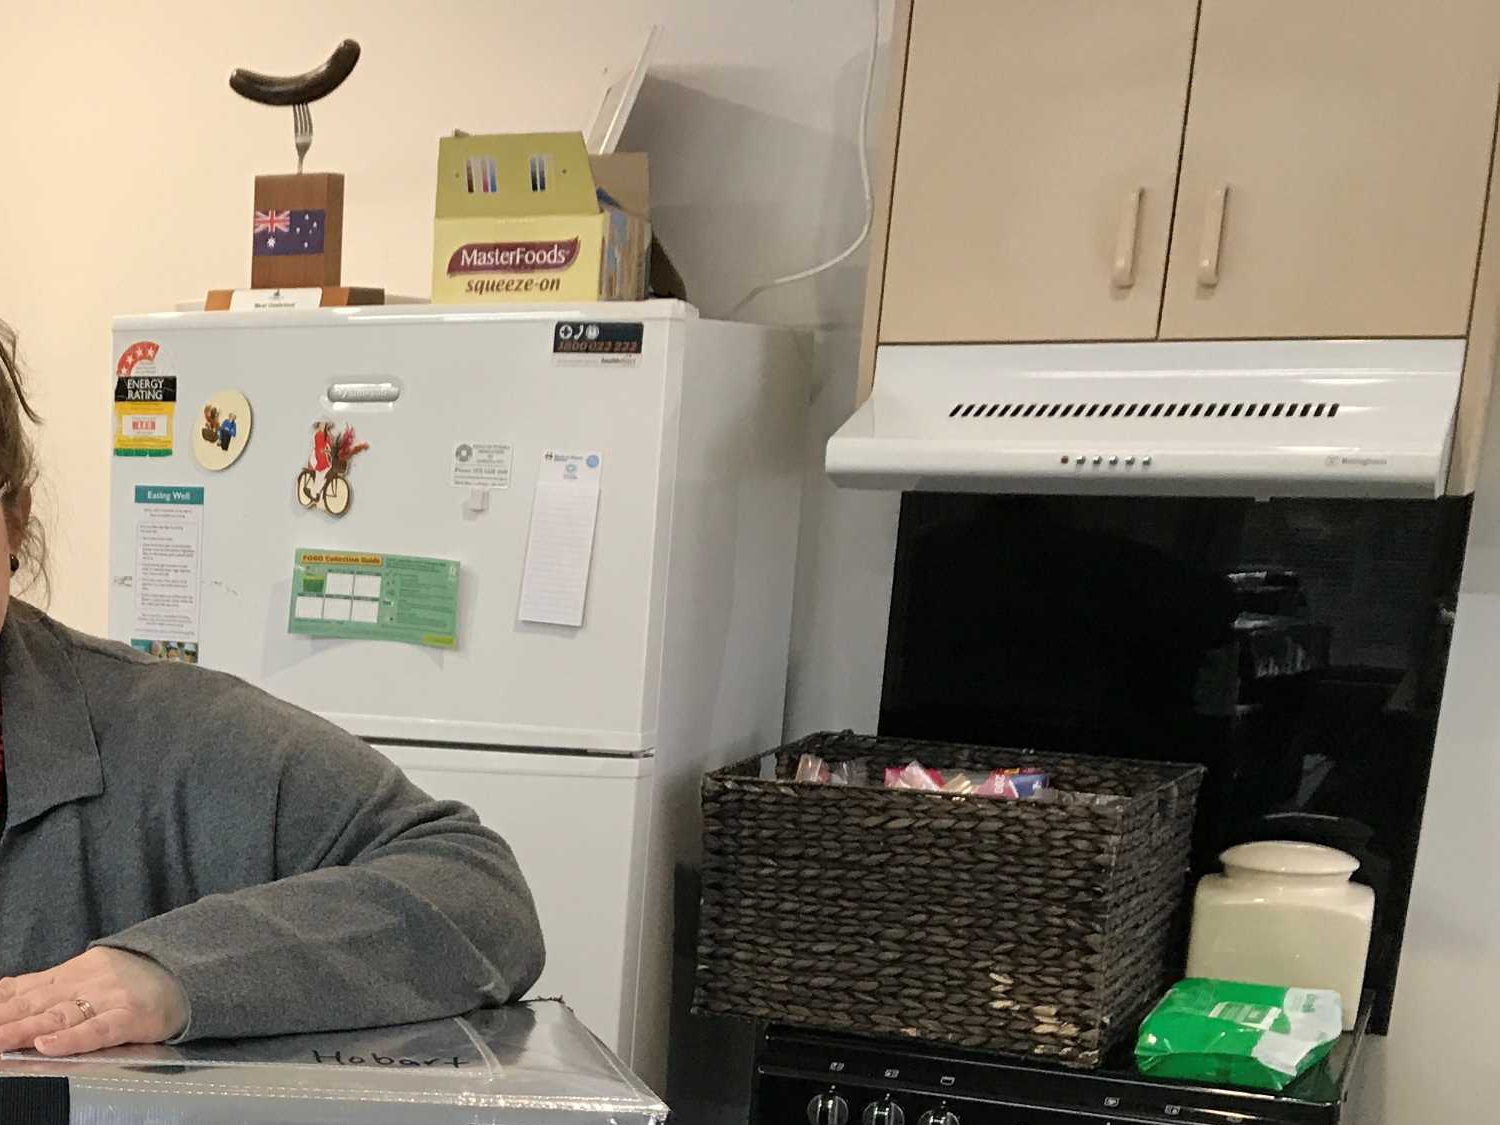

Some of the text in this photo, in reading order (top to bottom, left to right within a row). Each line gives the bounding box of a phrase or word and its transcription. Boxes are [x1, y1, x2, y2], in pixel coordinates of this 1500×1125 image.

[460, 247, 566, 267] MasterFoods
[465, 276, 561, 293] squeeze-on
[127, 379, 164, 389] ENERGY
[127, 390, 163, 401] RATING
[147, 491, 191, 502] Eating Well
[311, 1050, 469, 1069] Hobart
